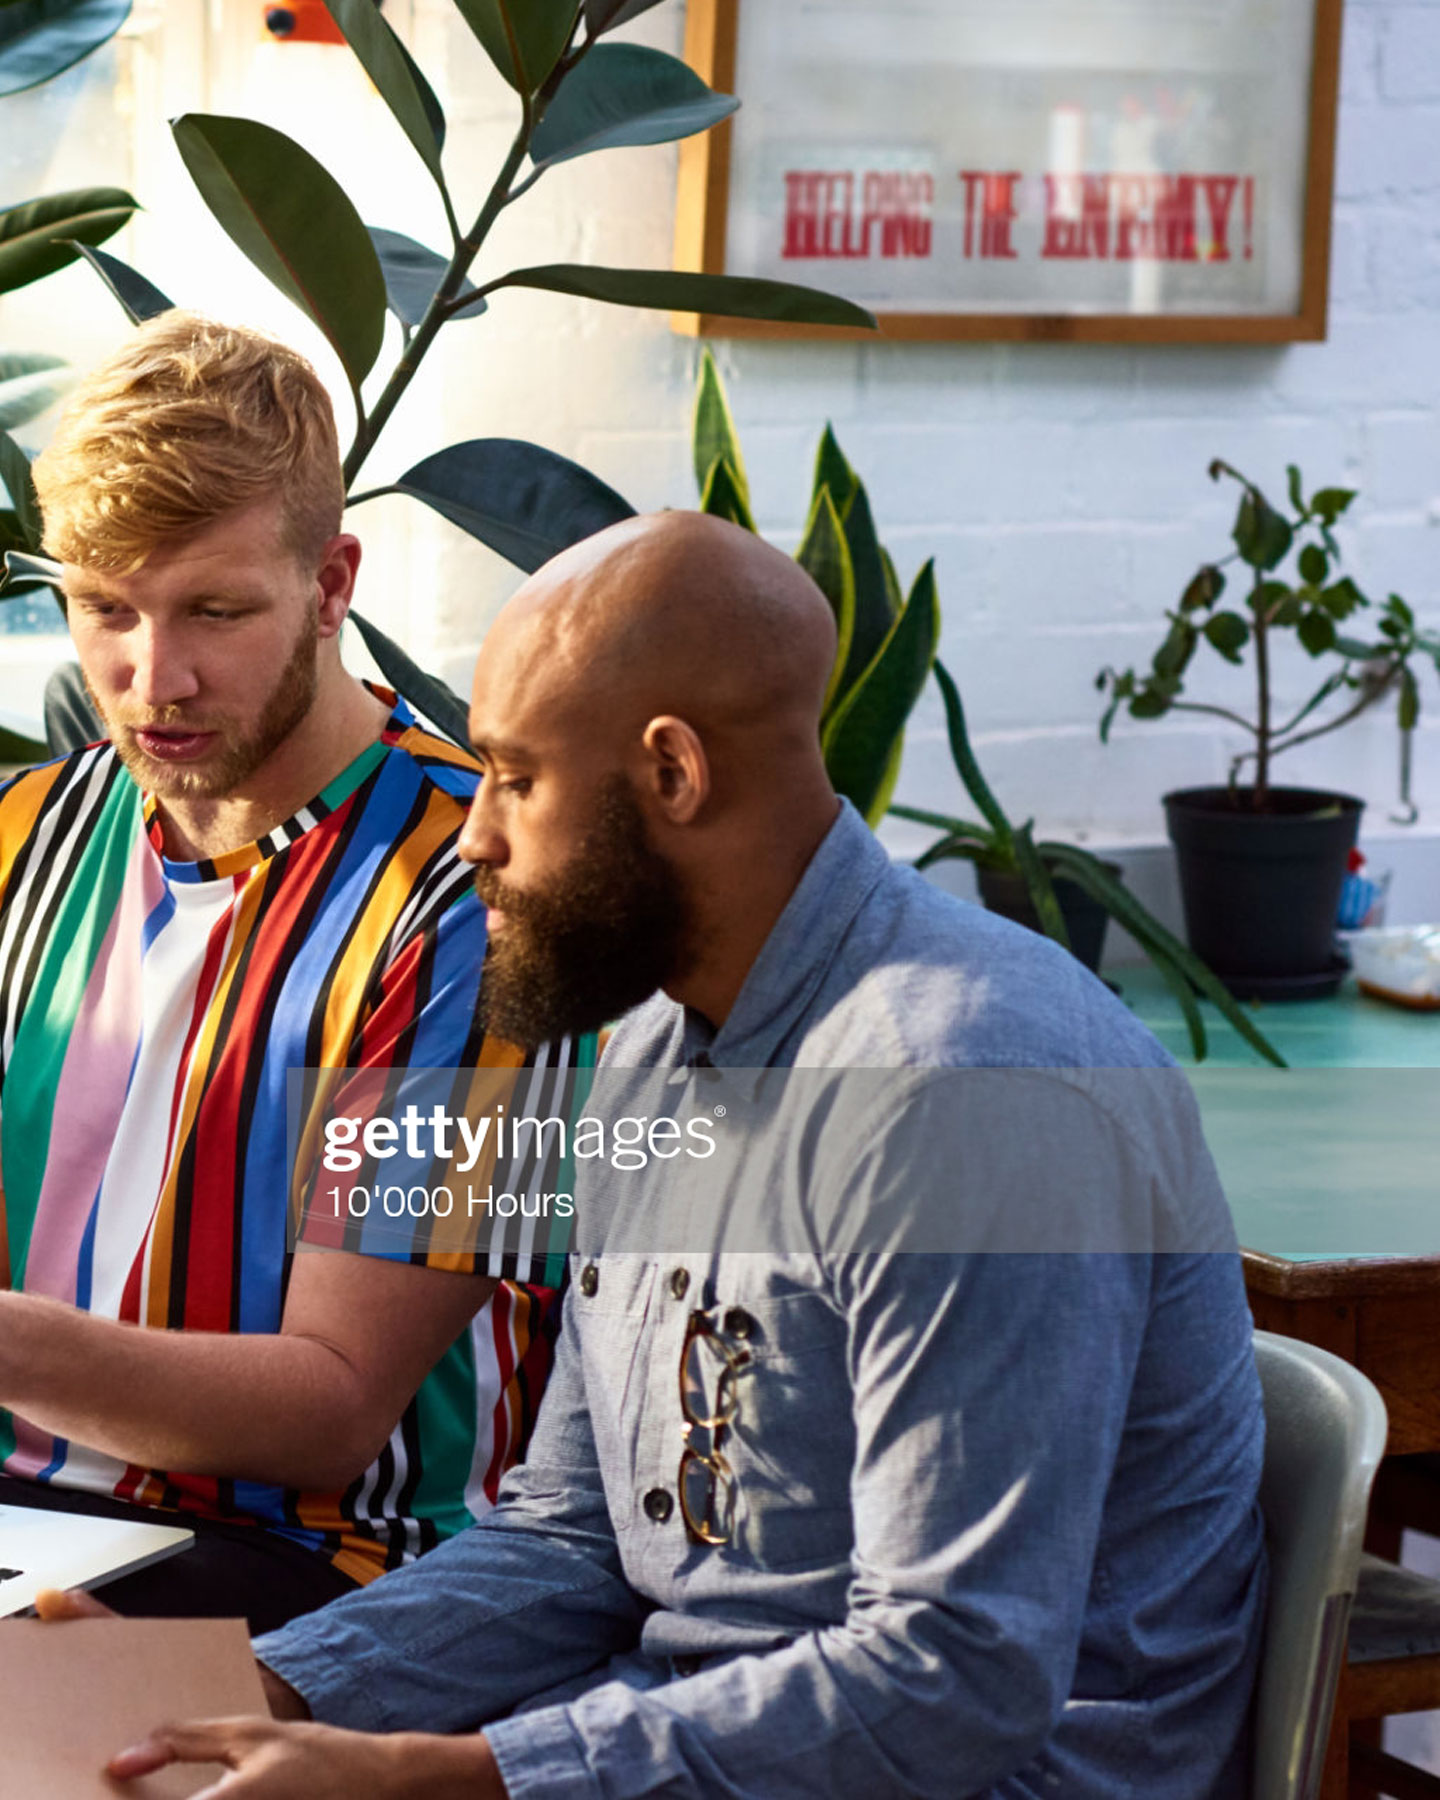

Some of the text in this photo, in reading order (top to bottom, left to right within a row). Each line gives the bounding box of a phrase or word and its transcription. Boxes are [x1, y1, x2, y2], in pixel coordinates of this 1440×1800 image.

[781, 170, 1255, 262] HELPING THE ENEMY!
